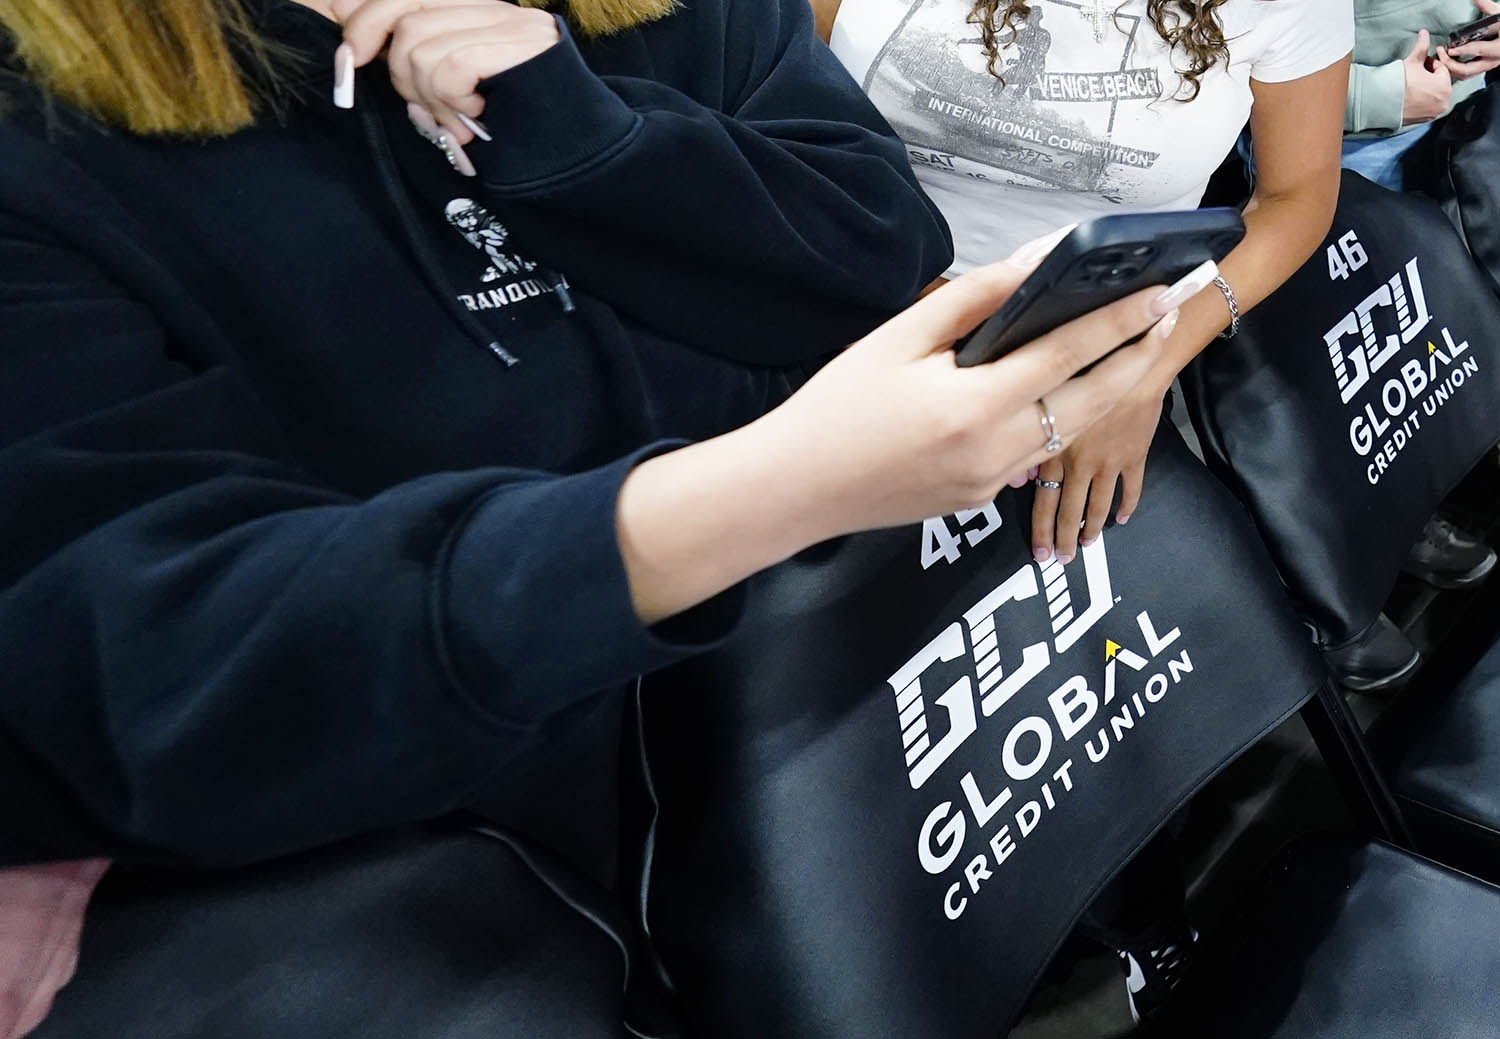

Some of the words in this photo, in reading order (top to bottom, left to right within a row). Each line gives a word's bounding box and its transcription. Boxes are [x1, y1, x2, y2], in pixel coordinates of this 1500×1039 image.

[928, 97, 1043, 143] INTERNATIONAL
[1048, 135, 1150, 168] COMPETITION
[1036, 73, 1100, 99] VENICE
[1101, 70, 1159, 97] BEACH
[1327, 229, 1369, 281] 46
[1323, 256, 1429, 404] GCU
[1350, 327, 1469, 456] GLOBAL
[1366, 409, 1421, 485] CREDIT
[1422, 356, 1479, 417] UNION
[918, 610, 1181, 874] GLOBAL
[944, 759, 1074, 920] CREDIT
[1084, 649, 1194, 764] UNION
